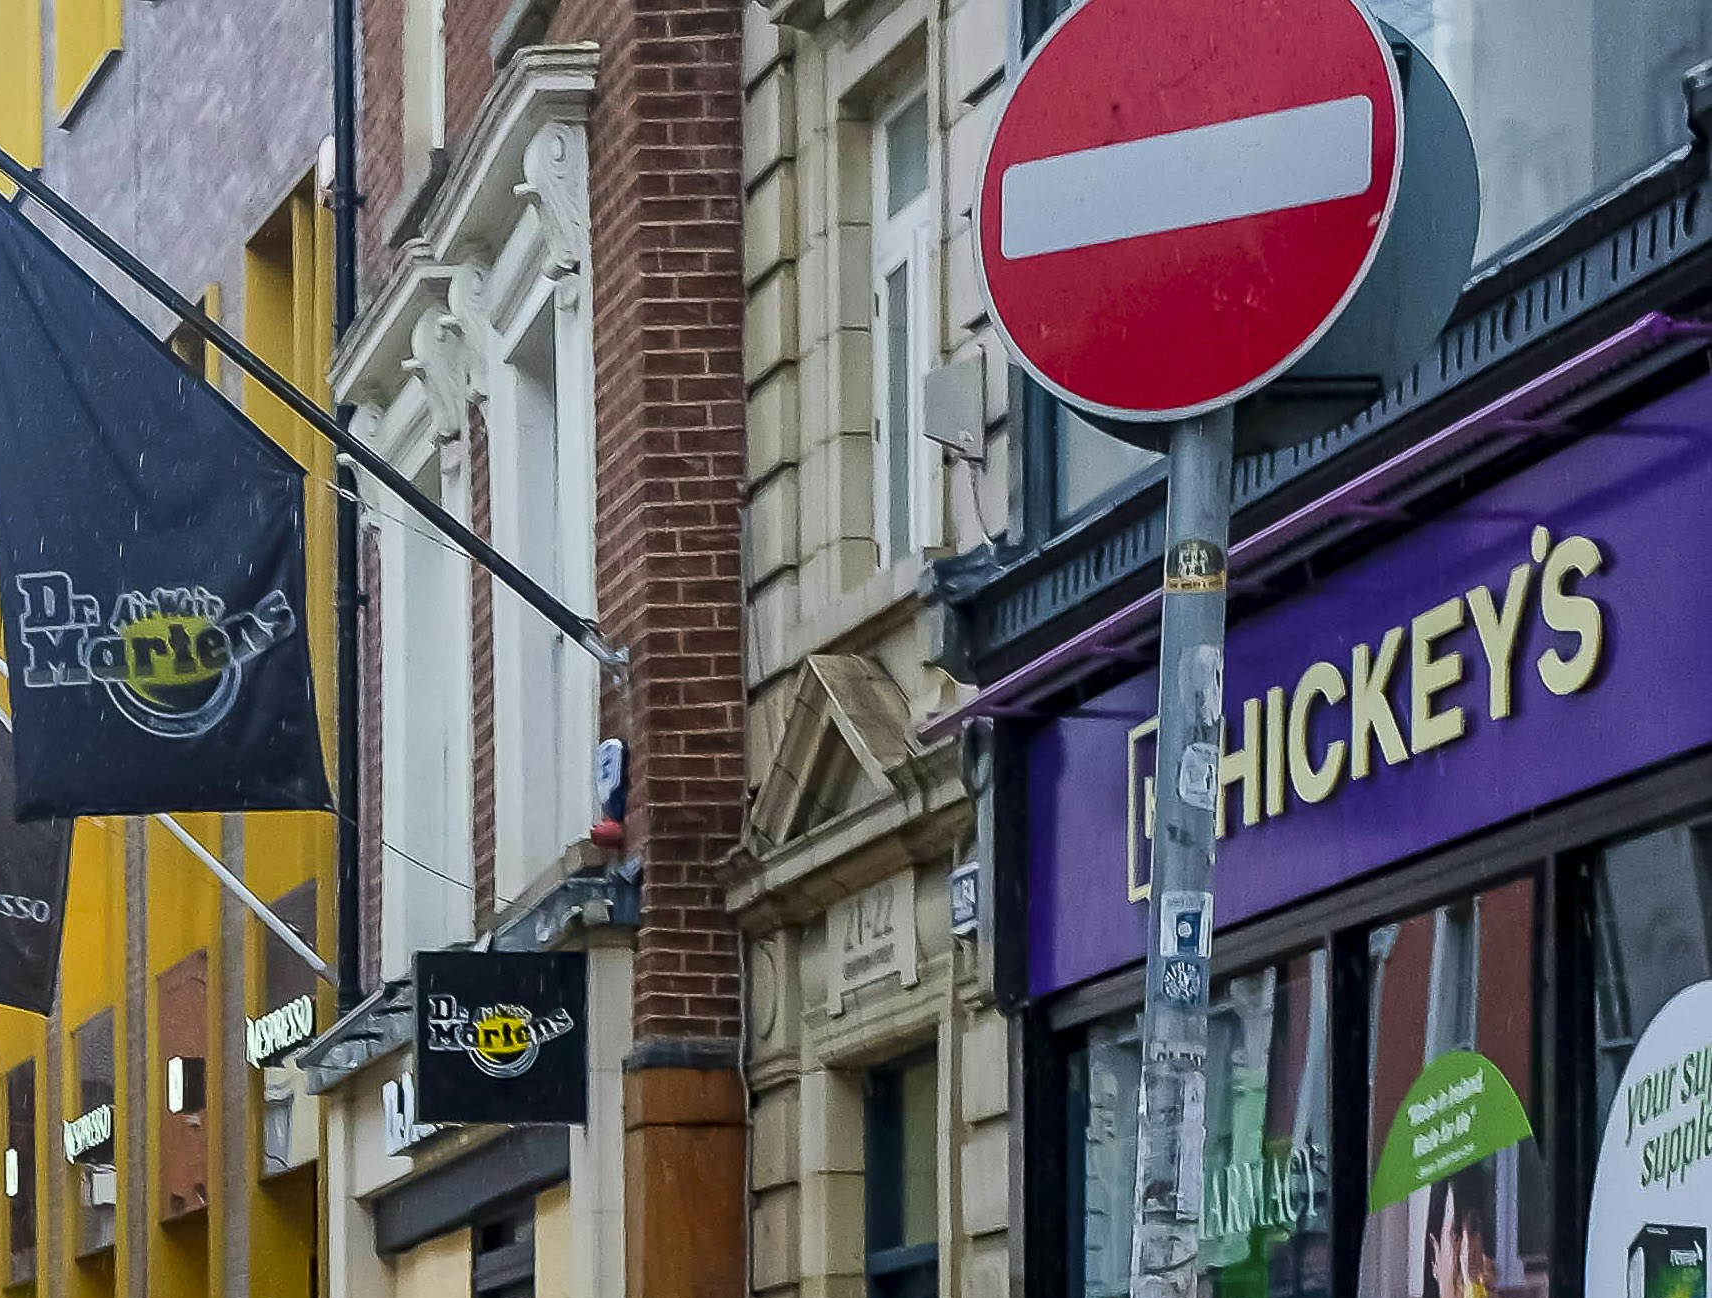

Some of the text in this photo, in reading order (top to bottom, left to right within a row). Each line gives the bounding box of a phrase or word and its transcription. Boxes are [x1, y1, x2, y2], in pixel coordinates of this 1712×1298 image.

[21, 589, 297, 688] Martens
[1215, 524, 1603, 840] HICKEY'S
[428, 1008, 575, 1051] Martens
[1626, 1063, 1677, 1146] your
